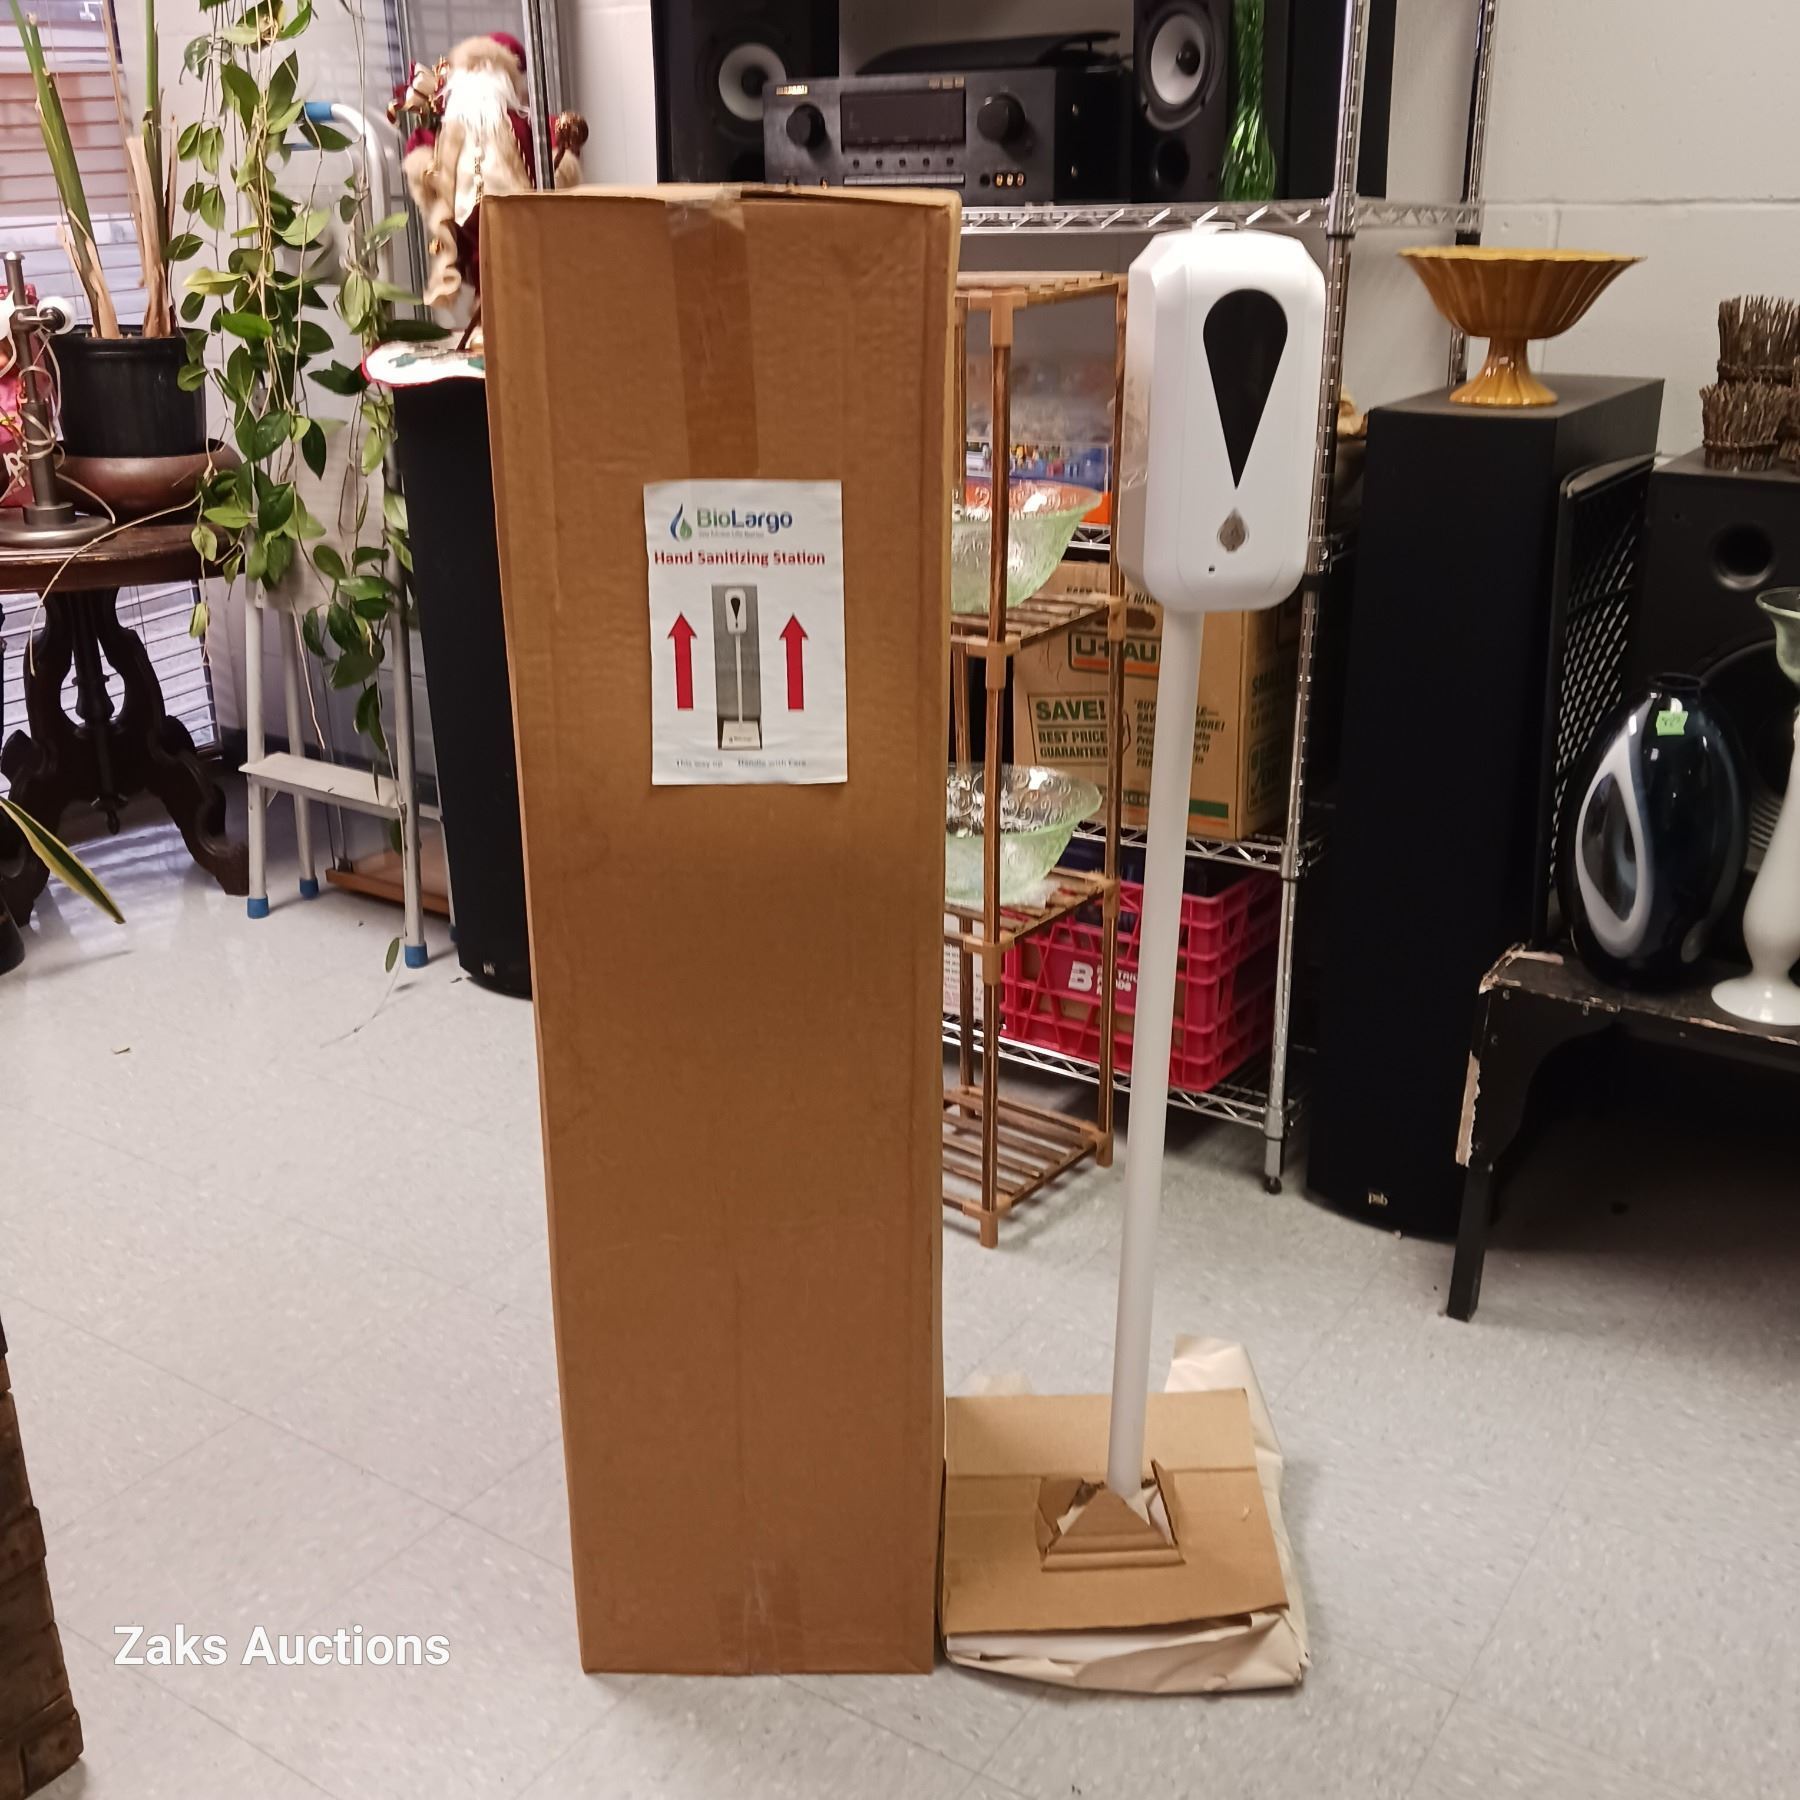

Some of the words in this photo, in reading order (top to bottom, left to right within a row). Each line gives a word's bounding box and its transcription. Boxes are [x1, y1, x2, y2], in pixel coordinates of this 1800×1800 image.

[697, 507, 793, 534] BioLargo
[654, 551, 693, 565] Hand
[698, 550, 769, 568] Sanitizing
[773, 550, 826, 566] Station
[1075, 636, 1157, 662] U-AU
[1036, 700, 1106, 720] SAVE!
[1039, 731, 1068, 743] BEST
